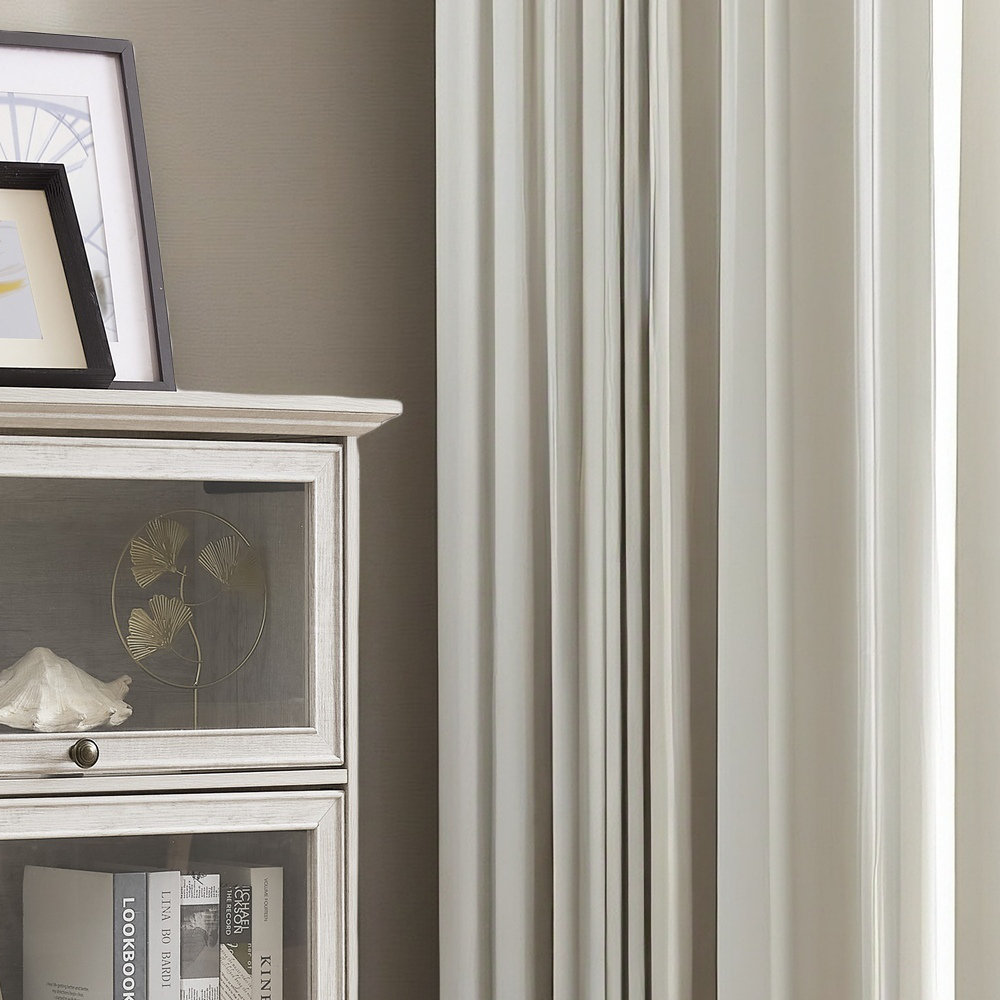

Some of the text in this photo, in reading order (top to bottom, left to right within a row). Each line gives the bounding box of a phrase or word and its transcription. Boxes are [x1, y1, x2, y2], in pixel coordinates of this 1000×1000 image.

[224, 905, 232, 936] RECORD
[233, 885, 244, 934] CKSON
[161, 890, 172, 988] LINA BO BARDI
